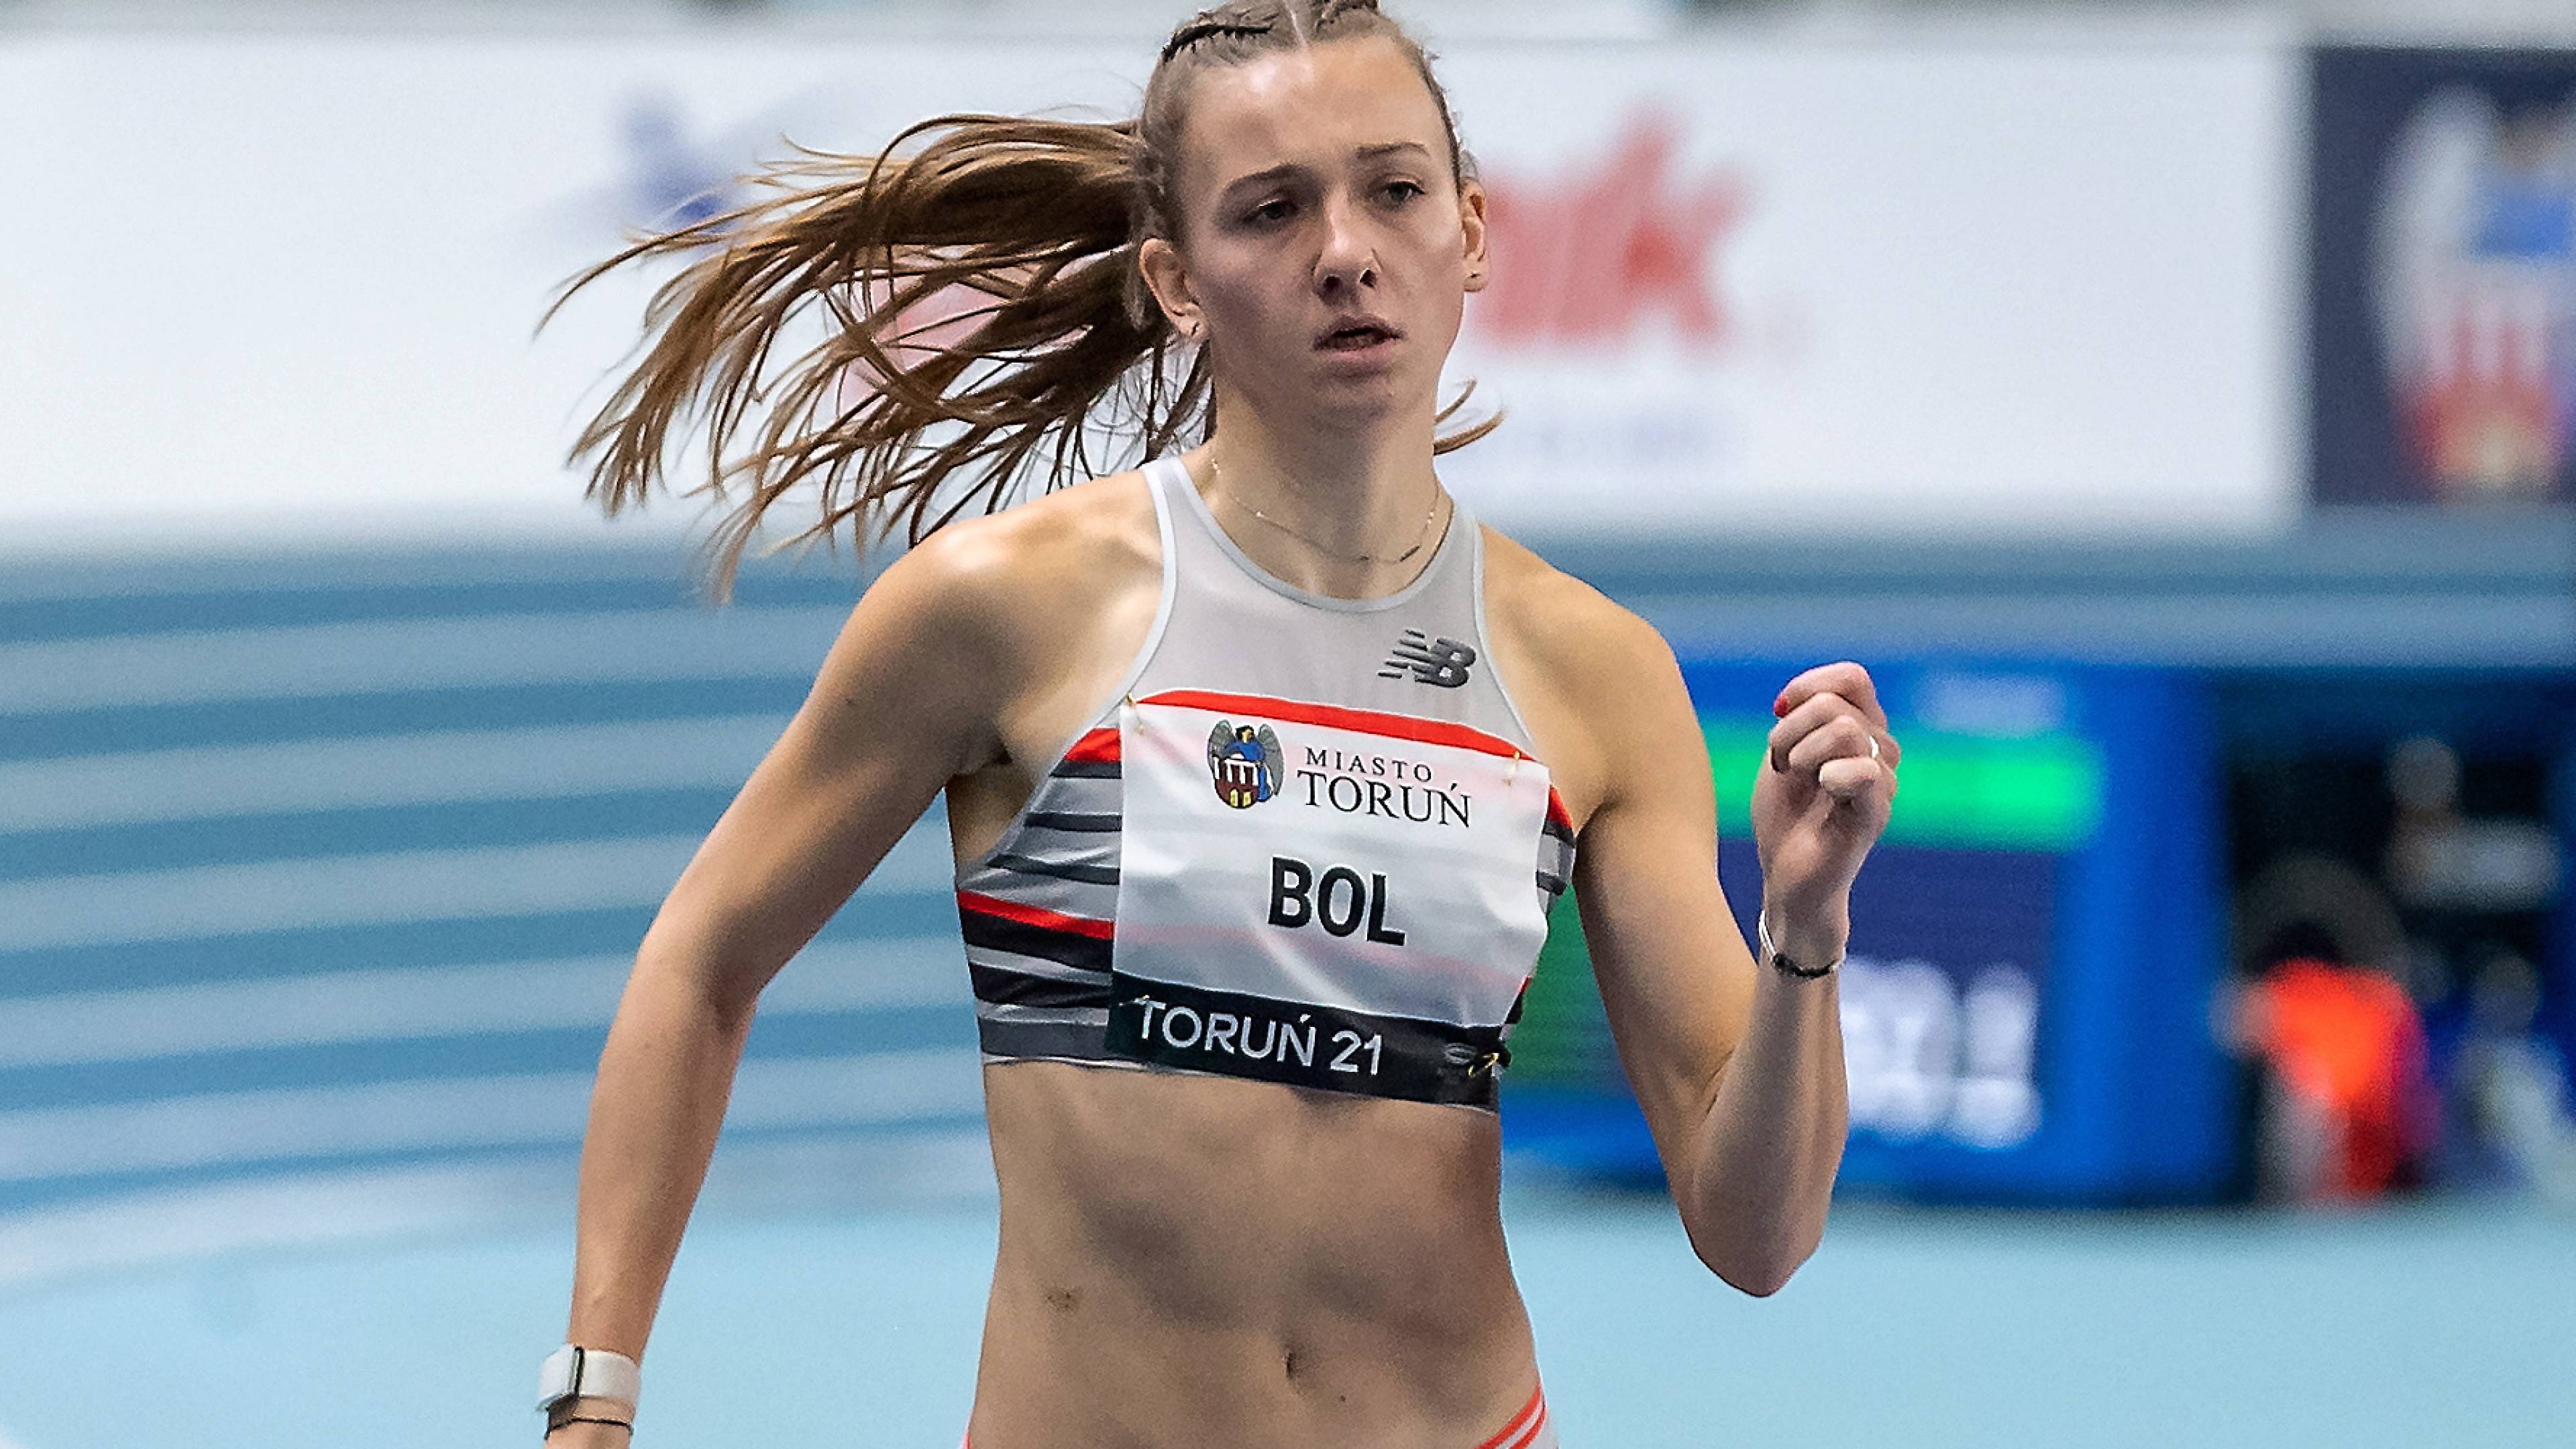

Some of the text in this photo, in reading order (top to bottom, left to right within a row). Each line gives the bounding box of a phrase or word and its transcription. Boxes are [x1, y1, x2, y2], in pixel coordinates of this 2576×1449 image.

[1305, 747, 1432, 782] MIASTO
[1297, 769, 1470, 827] TORUŃ
[1268, 857, 1405, 946] BOL
[1139, 1000, 1383, 1075] TORUŃ 21
